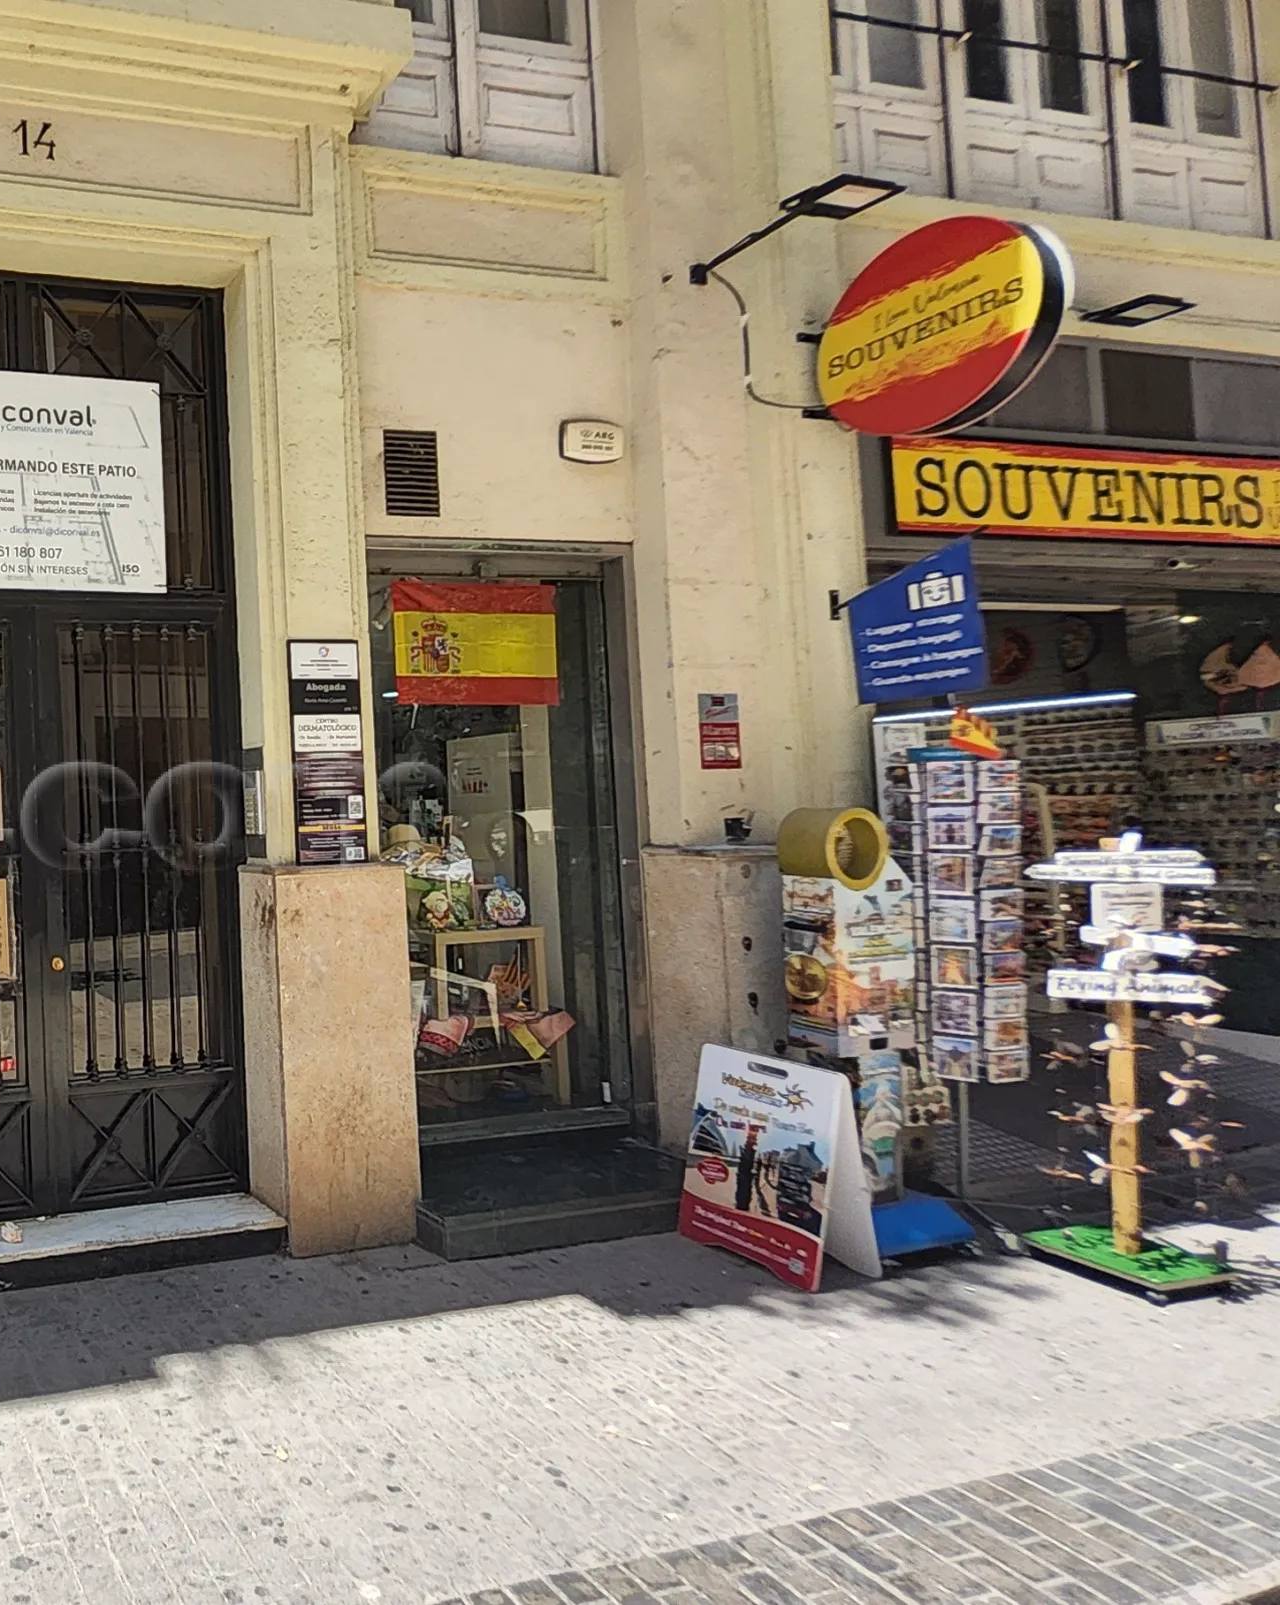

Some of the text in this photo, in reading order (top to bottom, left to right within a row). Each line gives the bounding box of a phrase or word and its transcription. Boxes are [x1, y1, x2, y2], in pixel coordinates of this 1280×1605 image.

[12, 119, 56, 161] 14
[827, 275, 1025, 380] SOUVENIRS
[6, 423, 53, 434] Construcción
[65, 427, 94, 437] Valencia
[62, 463, 95, 476] ESTE
[98, 464, 136, 478] PATIO
[915, 456, 1264, 530] SOUVENIRS
[14, 546, 36, 559] 180
[39, 547, 63, 560] 807
[18, 563, 35, 575] SIN
[37, 564, 88, 576] INTERESES
[122, 564, 140, 573] ISO
[305, 682, 346, 692] Abogada
